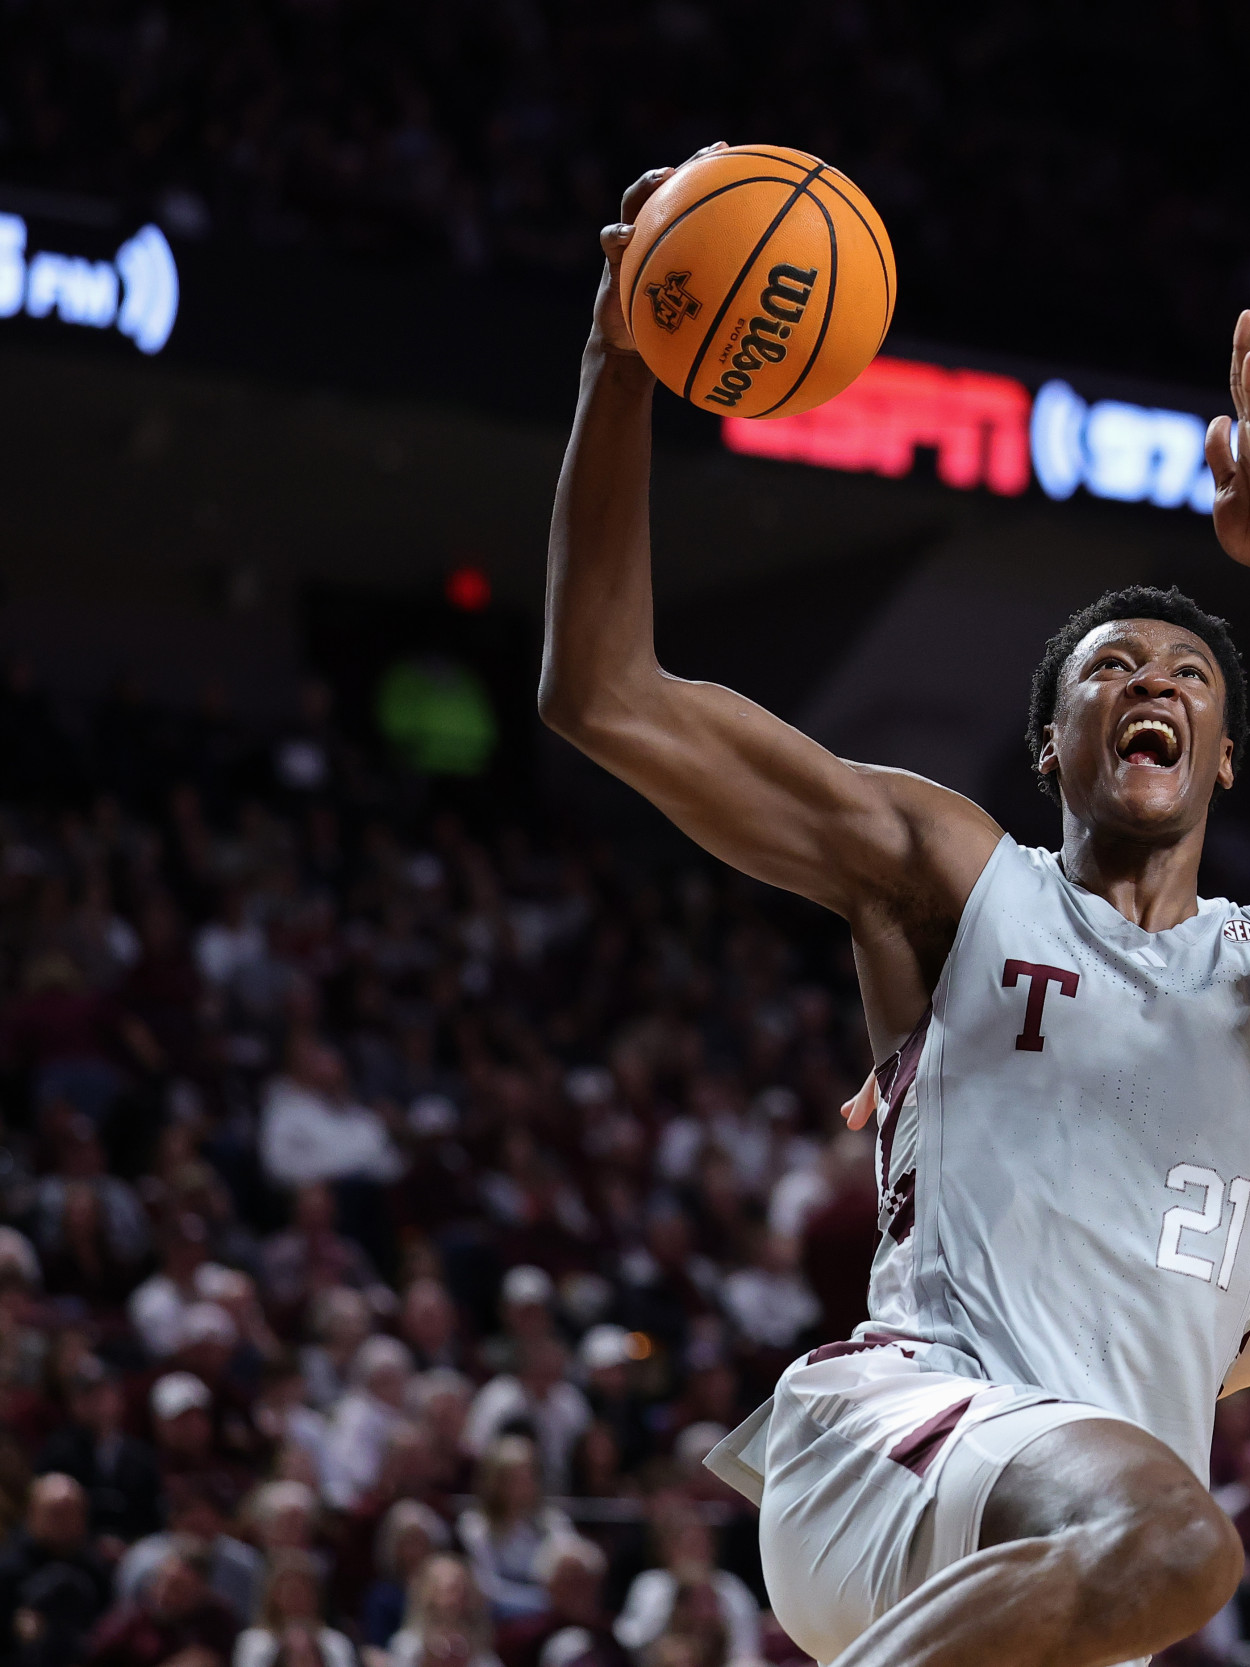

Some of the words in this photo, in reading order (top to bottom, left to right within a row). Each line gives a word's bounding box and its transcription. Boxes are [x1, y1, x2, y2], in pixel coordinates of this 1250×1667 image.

[704, 262, 819, 408] Wilson
[718, 343, 734, 365] NXT
[730, 318, 746, 342] EVO
[1001, 958, 1080, 1052] T
